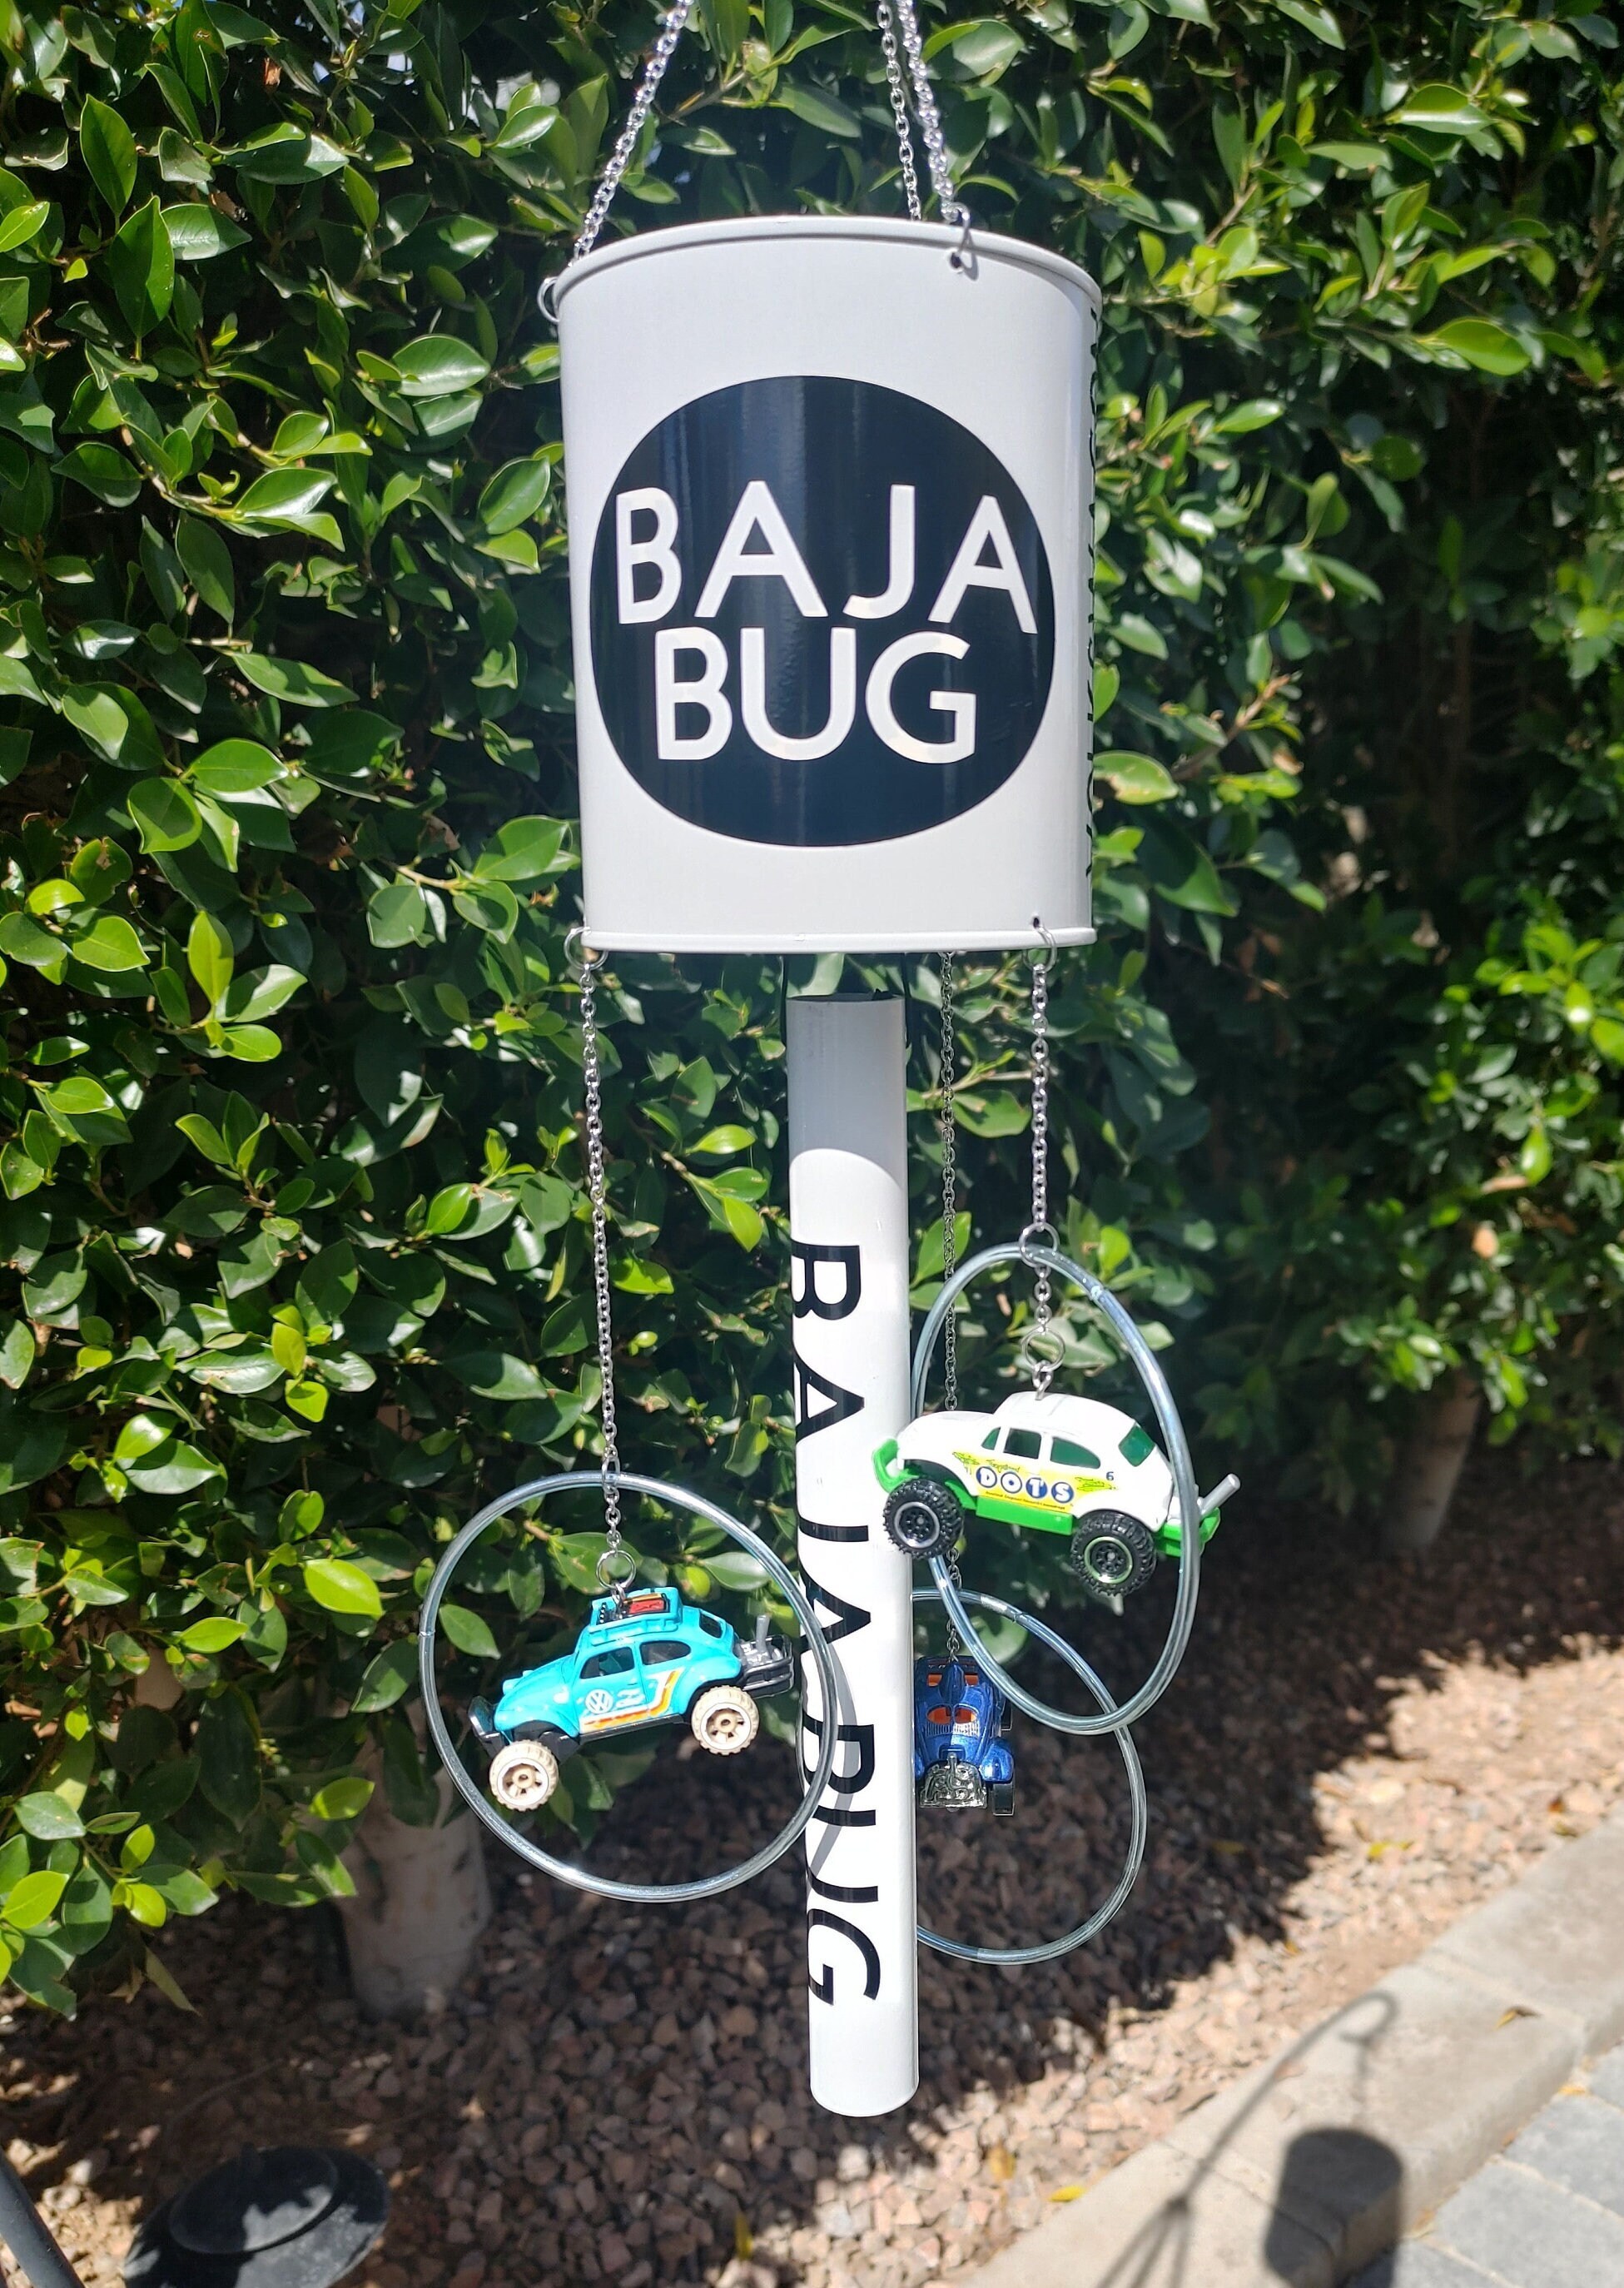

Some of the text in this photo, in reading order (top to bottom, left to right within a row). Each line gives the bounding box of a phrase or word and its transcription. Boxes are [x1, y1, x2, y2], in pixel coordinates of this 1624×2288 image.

[616, 480, 1038, 634] BAJA
[654, 626, 977, 764] BUG
[976, 1466, 1074, 1504] DOTS
[1105, 1471, 1115, 1481] 6
